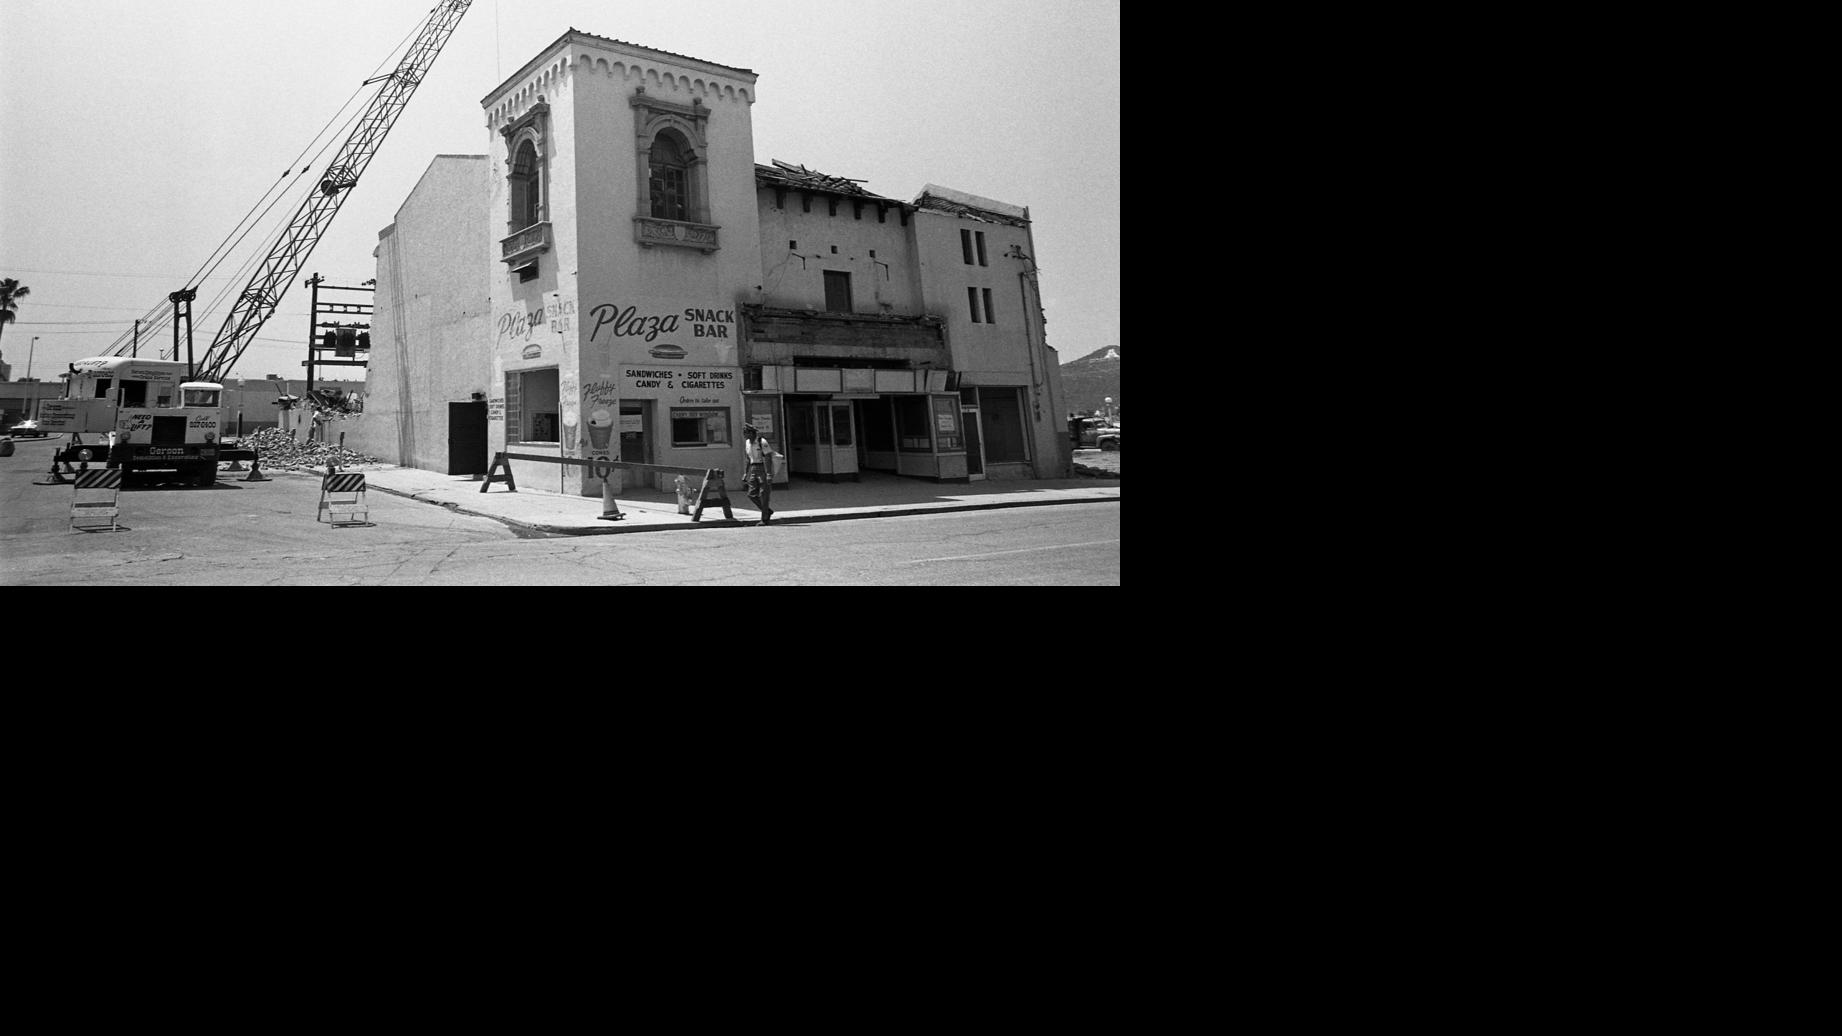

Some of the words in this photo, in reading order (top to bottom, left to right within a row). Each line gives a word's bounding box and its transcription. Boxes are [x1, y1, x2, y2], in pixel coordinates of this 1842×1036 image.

[590, 303, 680, 342] Plaza
[684, 308, 734, 323] SNACK
[496, 308, 545, 349] Plaza
[693, 324, 728, 338] BAR
[626, 369, 673, 379] SANDWICHES
[687, 371, 706, 380] SOFT
[709, 372, 733, 380] DRINKS
[583, 380, 616, 401] Fluffy
[636, 380, 661, 388] CANDY
[667, 381, 674, 389] &
[681, 381, 725, 389] CIGARETTES
